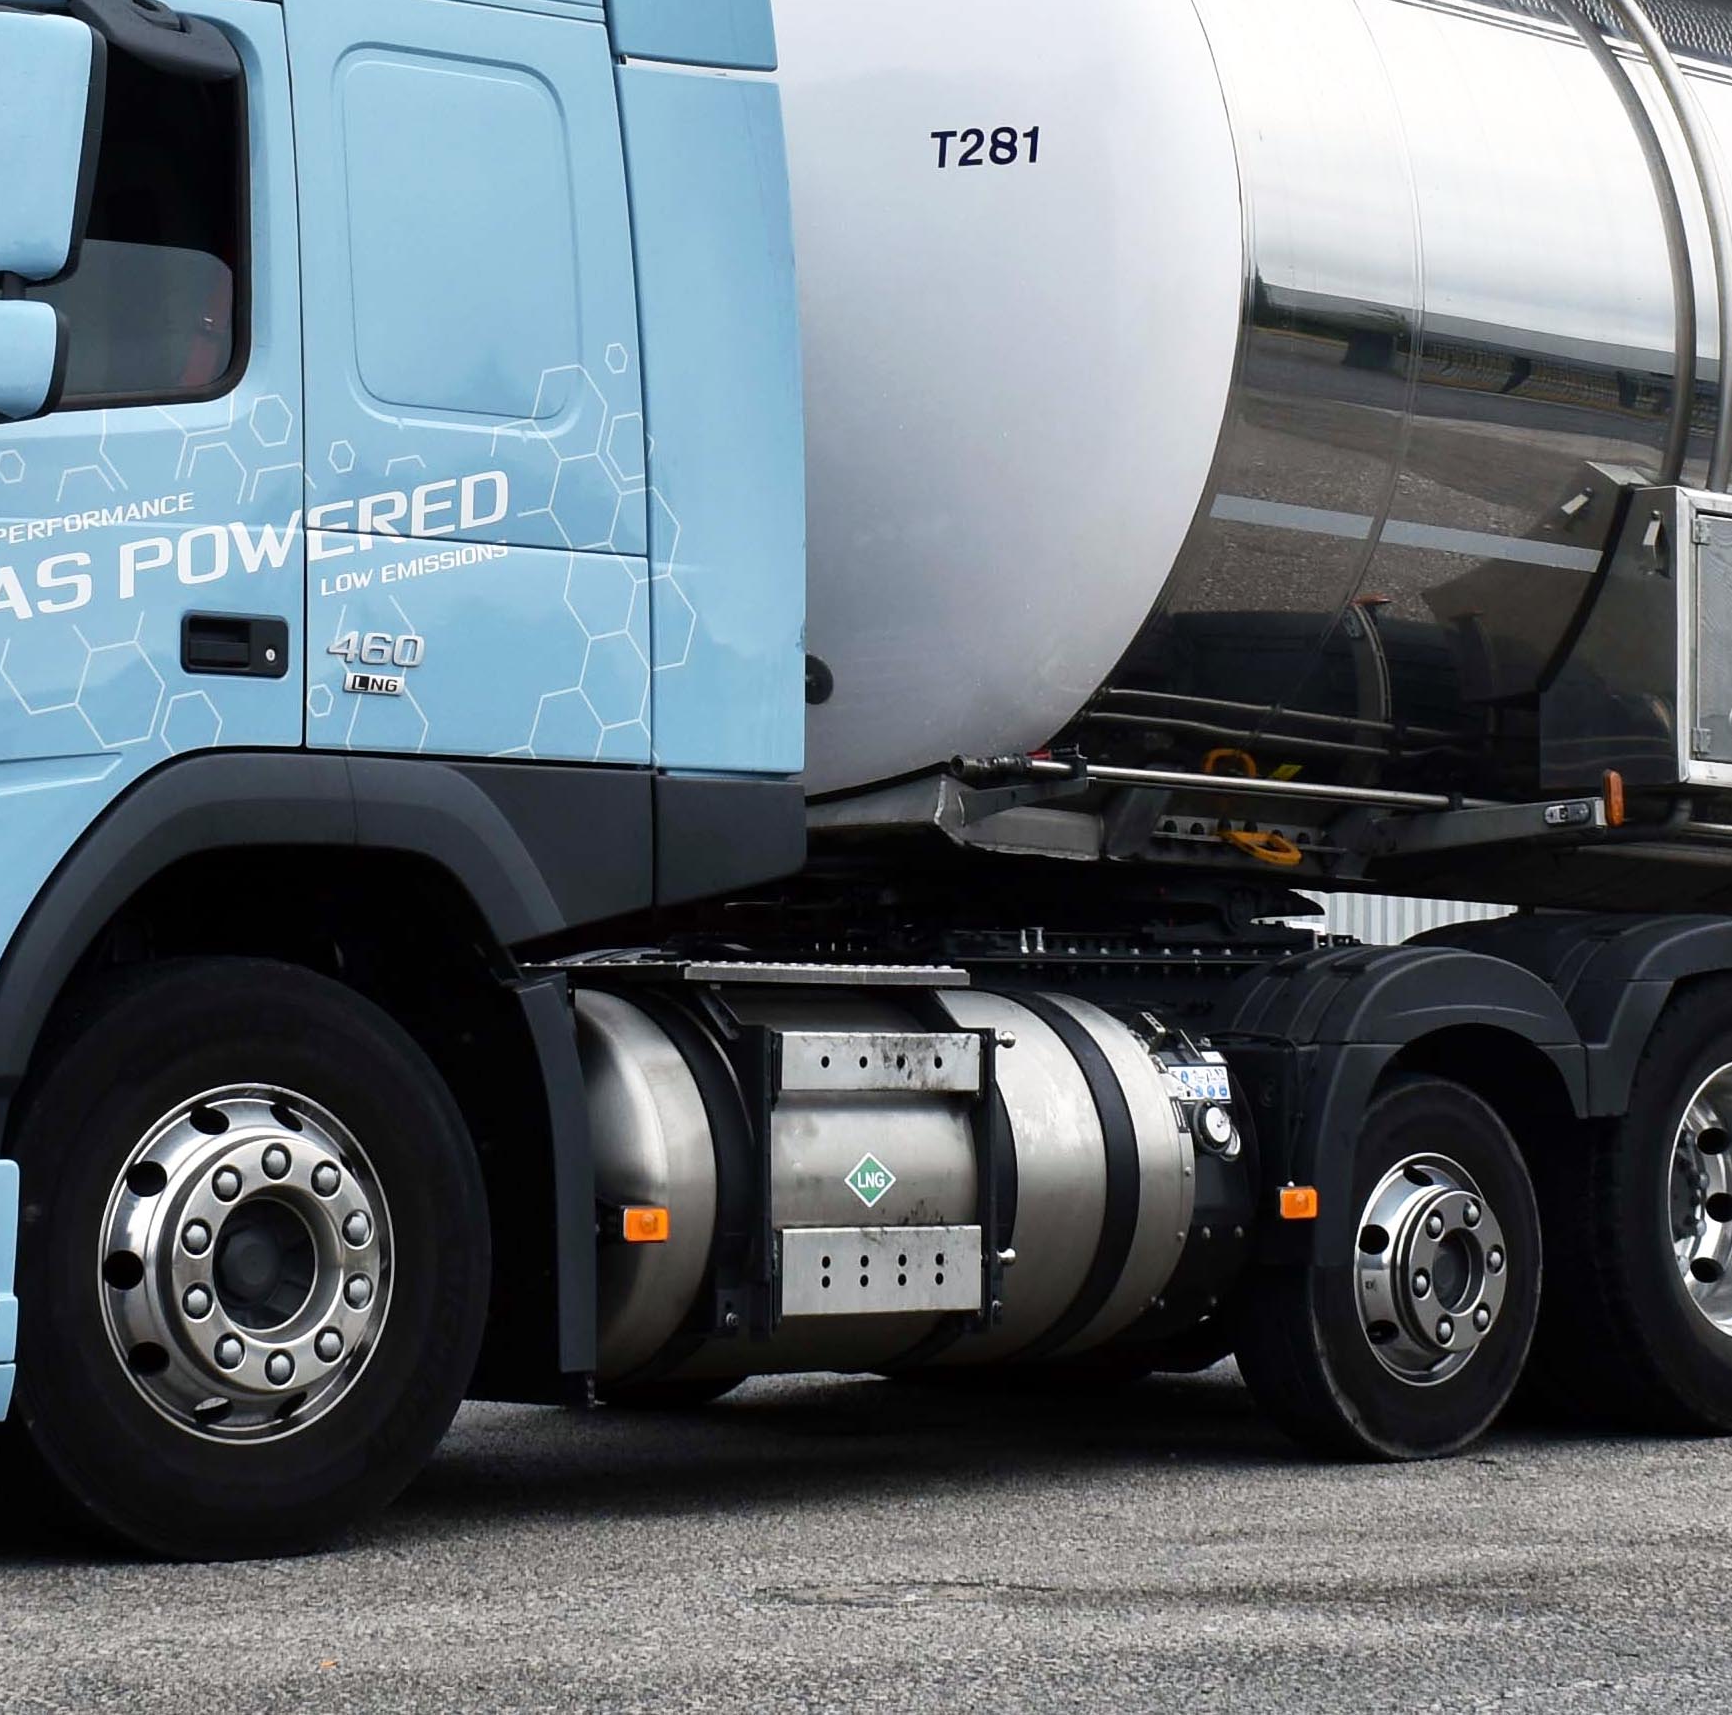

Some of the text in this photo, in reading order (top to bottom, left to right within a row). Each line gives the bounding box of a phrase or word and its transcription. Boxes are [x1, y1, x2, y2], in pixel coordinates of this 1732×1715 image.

[930, 126, 1039, 168] T281
[119, 470, 509, 600] POWERED
[321, 540, 508, 596] LOW EMISSIONS
[328, 630, 425, 667] 460
[351, 675, 399, 693] LNG
[857, 1172, 885, 1188] LNG
